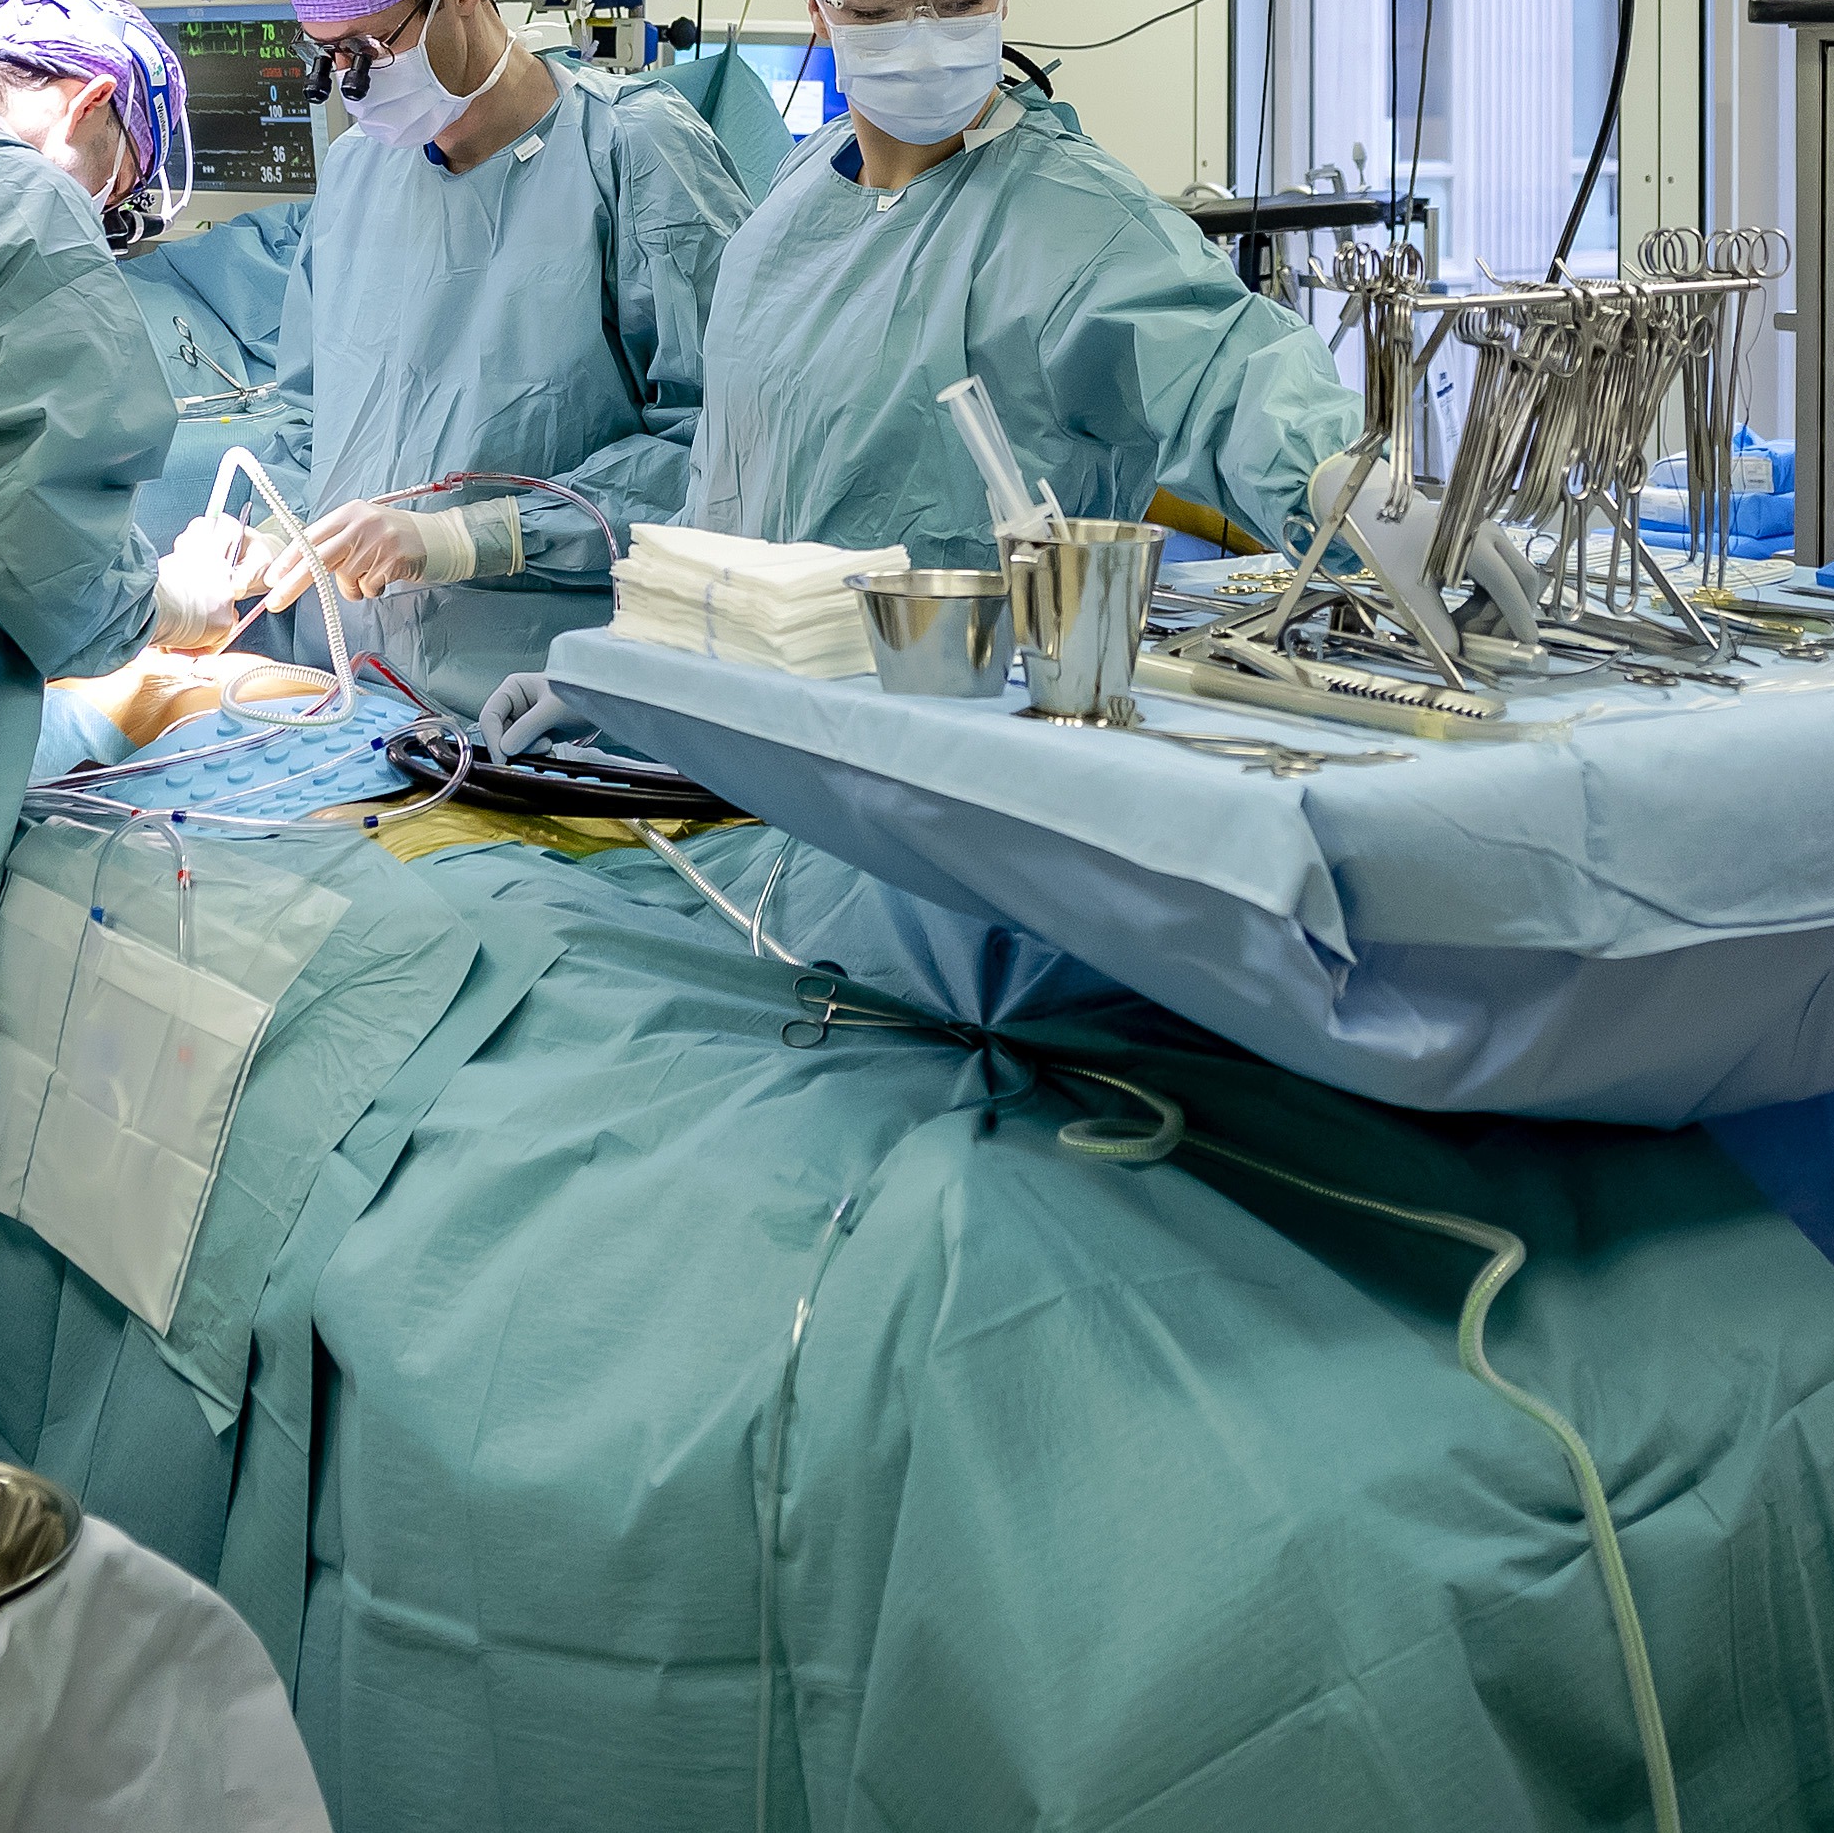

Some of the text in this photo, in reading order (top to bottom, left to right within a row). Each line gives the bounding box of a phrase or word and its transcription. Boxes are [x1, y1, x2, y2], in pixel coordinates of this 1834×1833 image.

[262, 24, 275, 41] 78
[270, 85, 277, 102] 0
[268, 105, 283, 118] 100
[272, 146, 286, 163] 36
